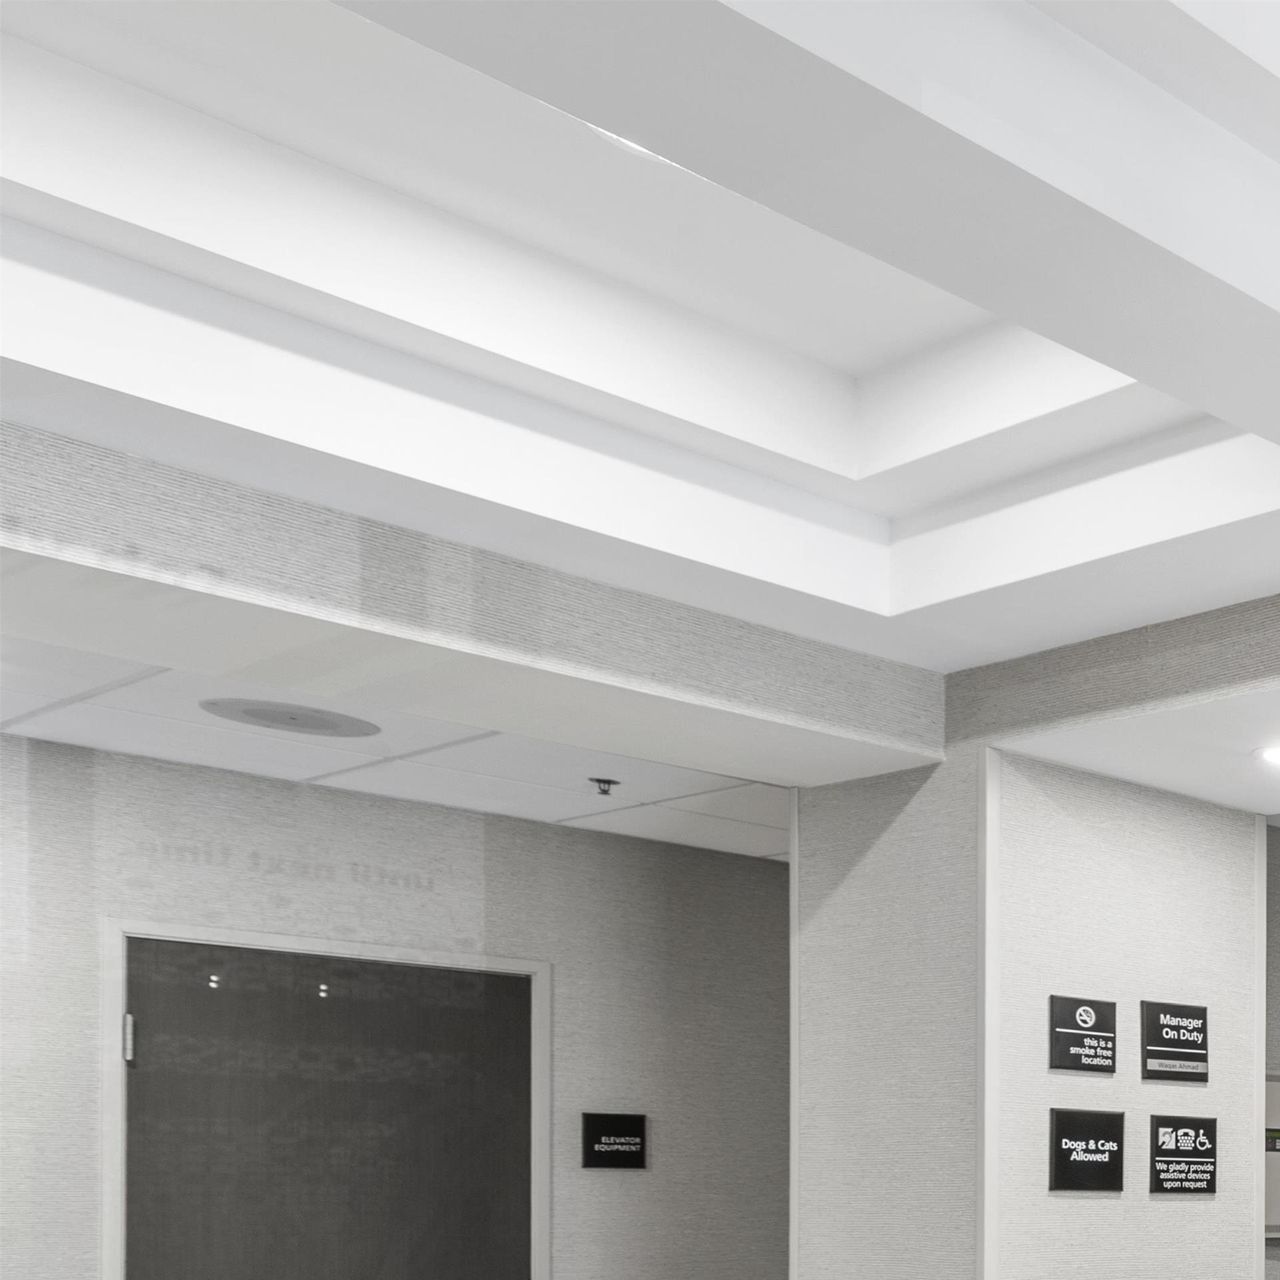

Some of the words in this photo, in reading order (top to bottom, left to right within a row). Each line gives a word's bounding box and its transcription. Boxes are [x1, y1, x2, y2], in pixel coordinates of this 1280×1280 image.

[1160, 1014, 1203, 1030] Manager
[1162, 1028, 1178, 1039] On
[1180, 1029, 1203, 1044] Duty
[1083, 1037, 1098, 1047] this
[1099, 1038, 1106, 1048] is
[1070, 1046, 1096, 1056] smoke
[1096, 1047, 1113, 1057] free
[1081, 1055, 1113, 1066] location
[1062, 1138, 1087, 1151] Dogs
[1088, 1139, 1096, 1150] &
[1098, 1140, 1118, 1151] Cats
[1070, 1151, 1109, 1161] Allowed
[1155, 1162, 1167, 1170] We
[1169, 1162, 1189, 1172] gladly
[1190, 1163, 1214, 1174] provide
[1160, 1171, 1186, 1179] assistive
[1187, 1171, 1211, 1180] devices
[1163, 1181, 1181, 1190] upon
[1182, 1181, 1207, 1190] request
